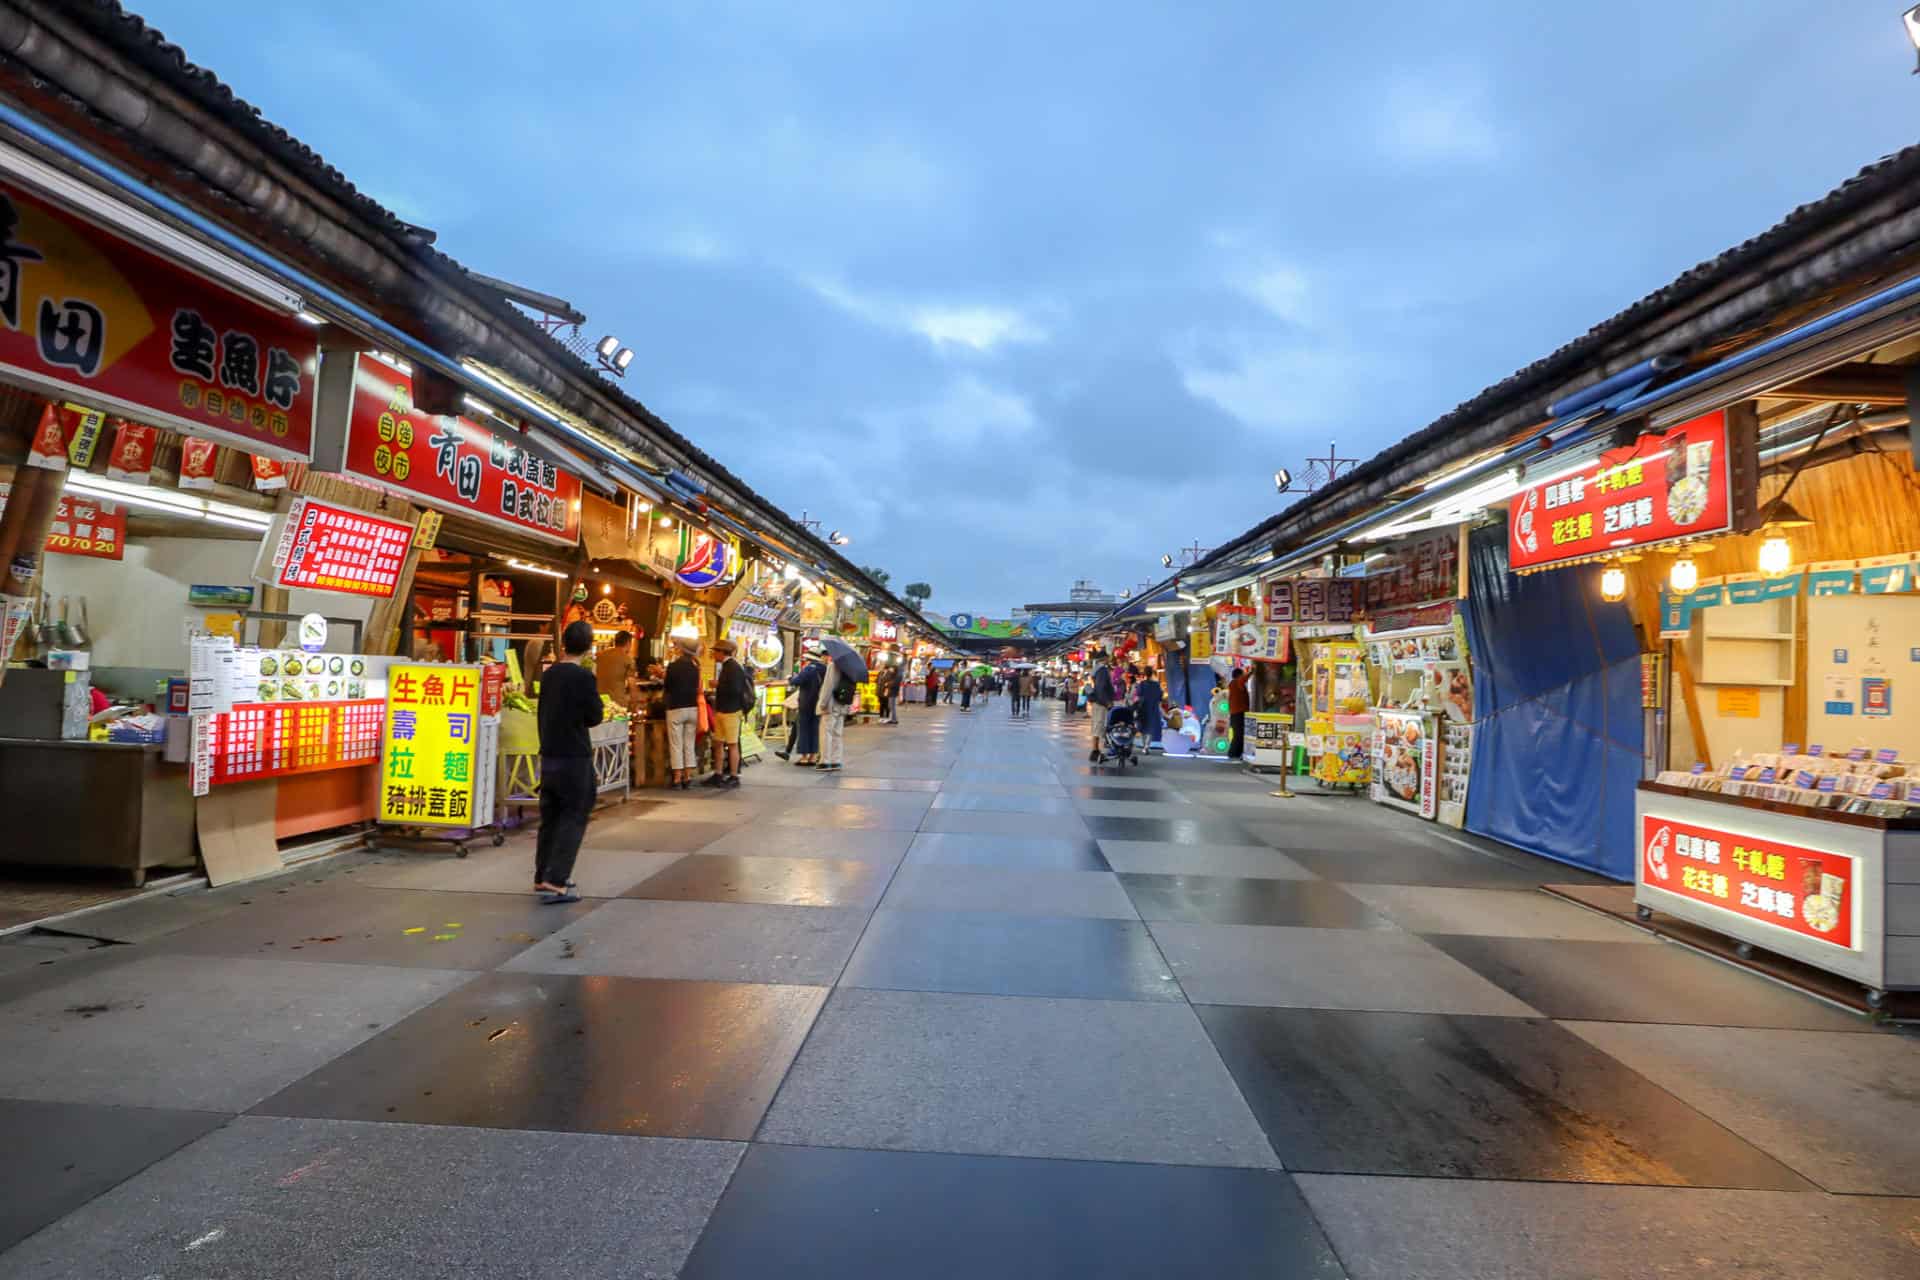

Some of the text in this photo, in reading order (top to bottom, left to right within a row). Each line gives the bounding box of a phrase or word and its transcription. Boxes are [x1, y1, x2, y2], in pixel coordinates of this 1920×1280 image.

[171, 309, 300, 408] 生魚片
[181, 382, 287, 436] 原自強夜市
[75, 412, 98, 463] 自強夜市
[379, 415, 412, 447] 自強
[375, 447, 409, 478] 夜市
[429, 415, 481, 499] 青田
[1545, 477, 1585, 509] 四喜糖
[1596, 458, 1643, 494] 牛軋糖
[502, 480, 565, 529] 日式拉麵
[1603, 497, 1653, 534] 芝麻糖
[50, 534, 115, 553] 70 70 20
[1551, 512, 1593, 545] 花生糖
[393, 673, 474, 707] 生魚片
[392, 710, 472, 744] 壽司
[390, 746, 470, 782] 拉麵
[387, 785, 467, 818] 豬排蓋飯
[1675, 833, 1721, 864] 四喜糖
[1682, 866, 1728, 898] 花生糖
[1740, 882, 1794, 918] 芝麻糖
